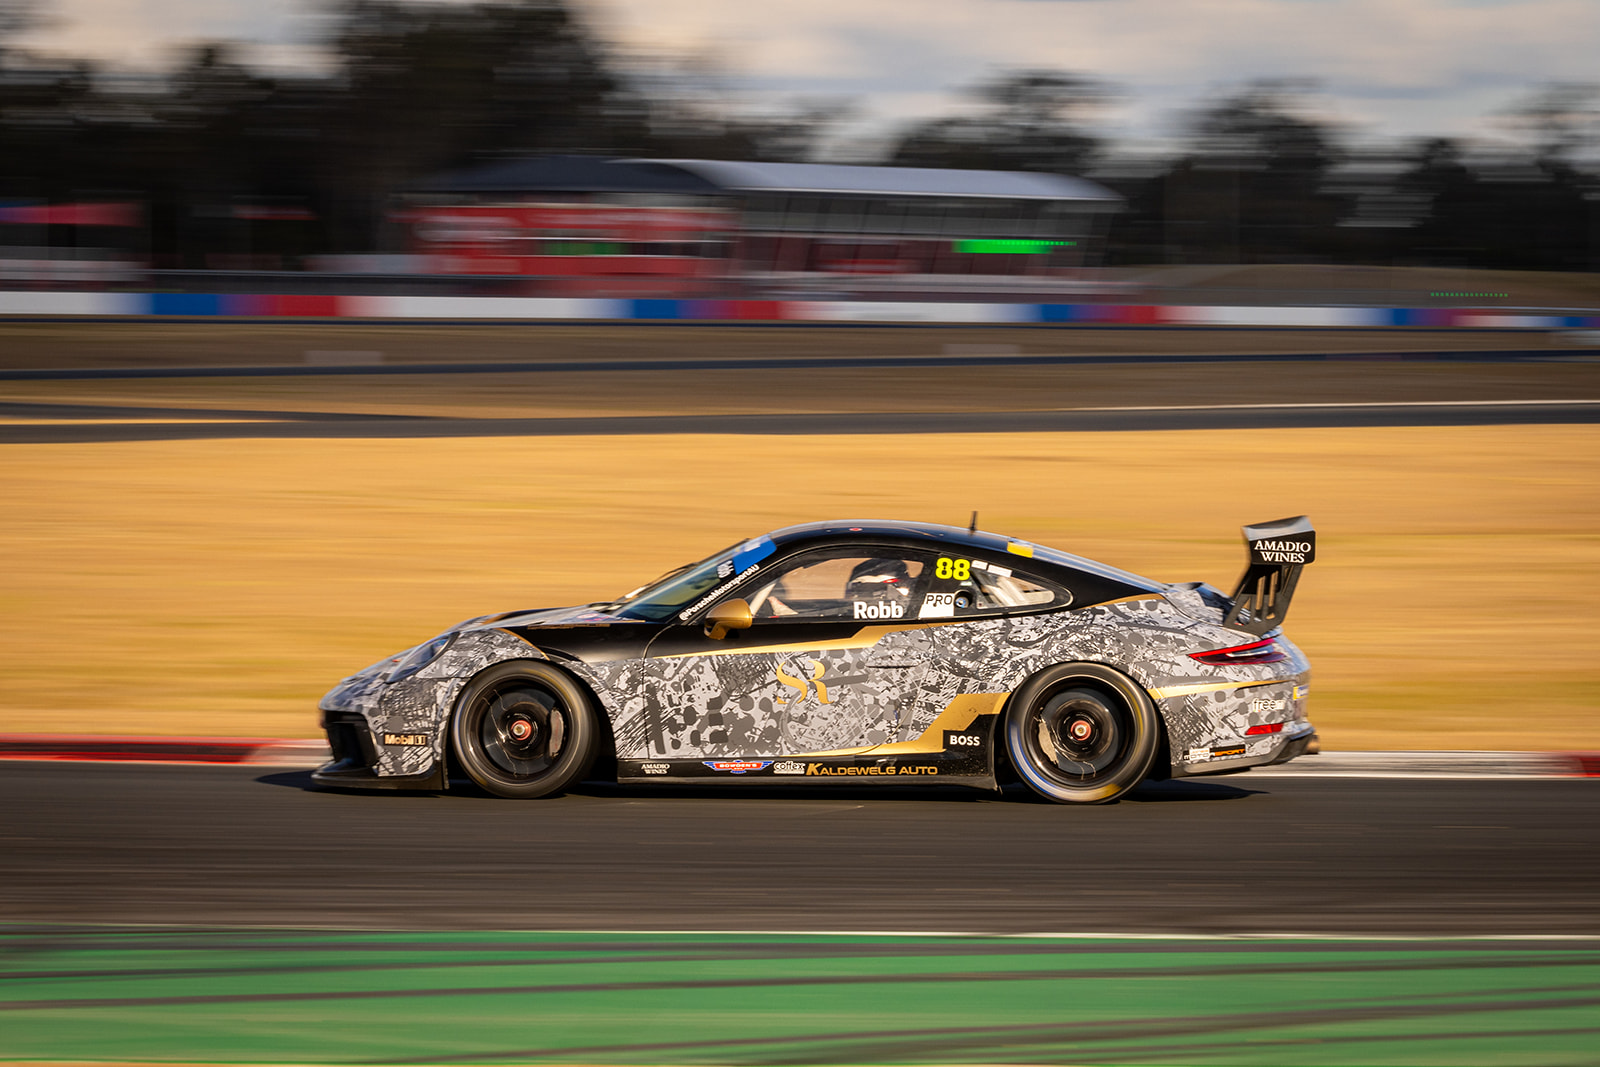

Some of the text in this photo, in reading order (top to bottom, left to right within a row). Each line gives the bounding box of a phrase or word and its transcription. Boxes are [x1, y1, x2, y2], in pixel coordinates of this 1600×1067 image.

[1254, 540, 1311, 552] AMADIO
[1260, 551, 1305, 563] WINES
[935, 557, 970, 580] 88
[679, 564, 760, 620] @PorscheMotorsportAU
[925, 594, 953, 605] PRO
[853, 600, 904, 619] Robb
[385, 734, 414, 745] Mobil
[950, 735, 980, 746] BOSS
[773, 760, 806, 770] coffex
[806, 763, 938, 776] KALDEWELG AUTO
